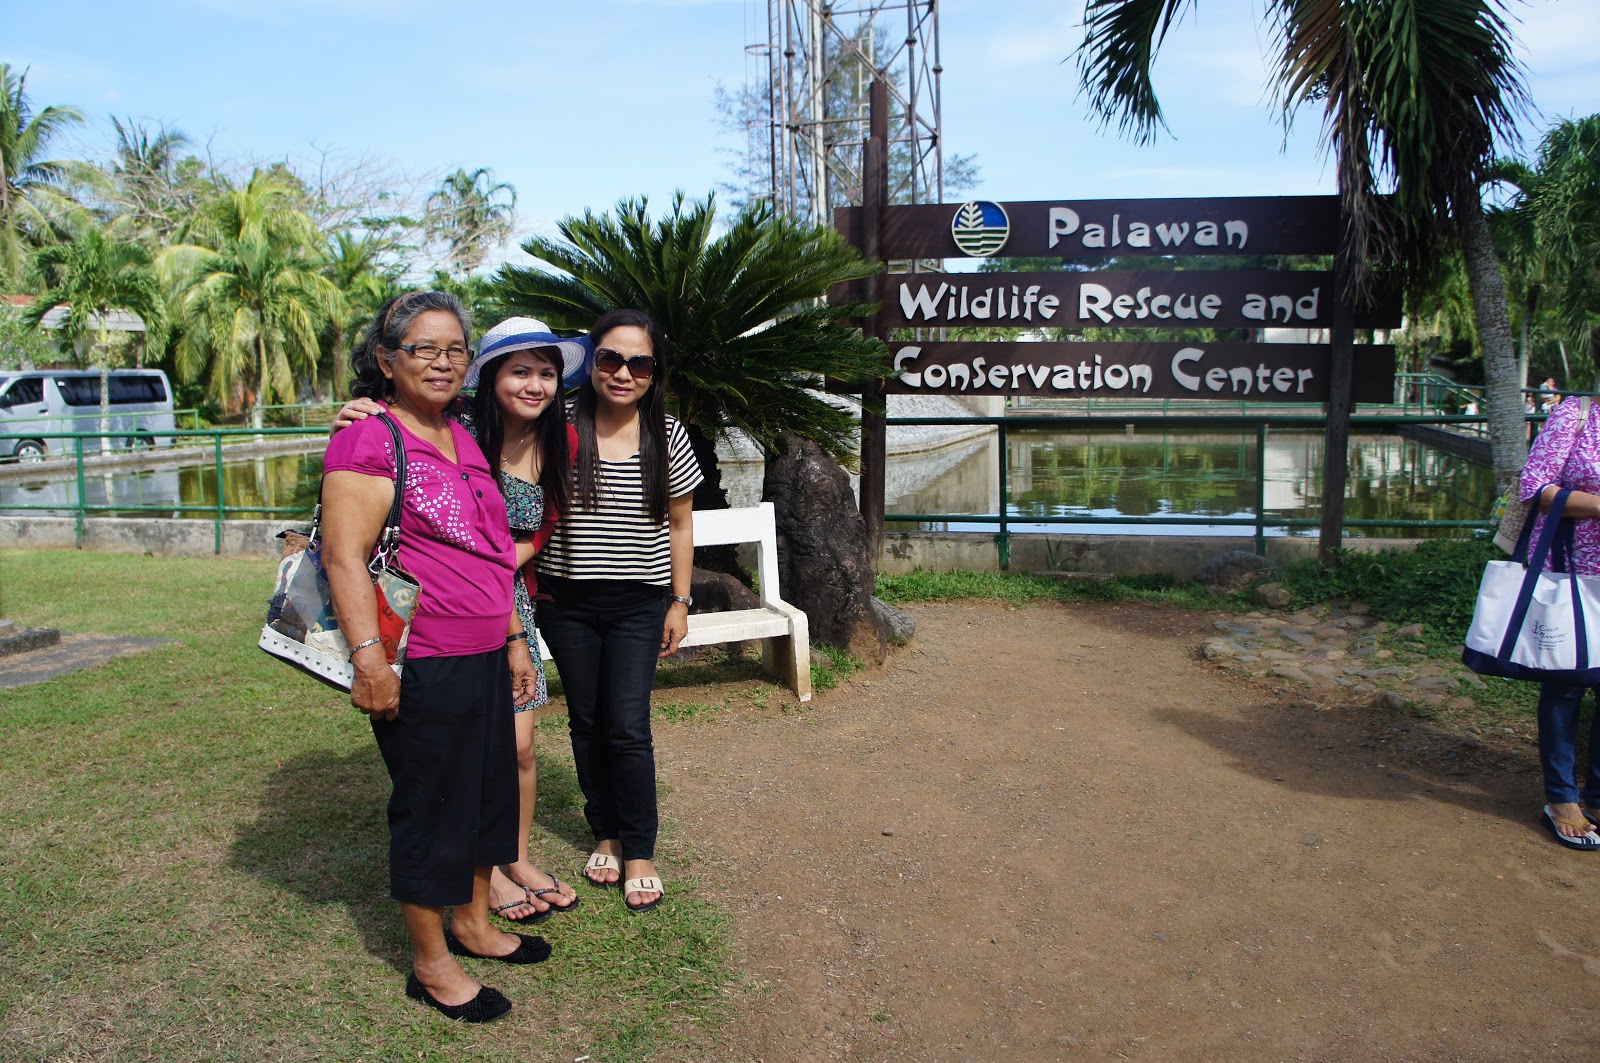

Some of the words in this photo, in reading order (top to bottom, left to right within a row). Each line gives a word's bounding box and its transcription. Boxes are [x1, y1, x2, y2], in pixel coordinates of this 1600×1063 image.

[1048, 207, 1249, 249] Palawan
[898, 282, 1060, 321] Wildlife
[1079, 283, 1222, 324] Rescue
[1241, 286, 1319, 323] and
[893, 345, 1154, 393] Conservation
[1171, 347, 1314, 394] Center
